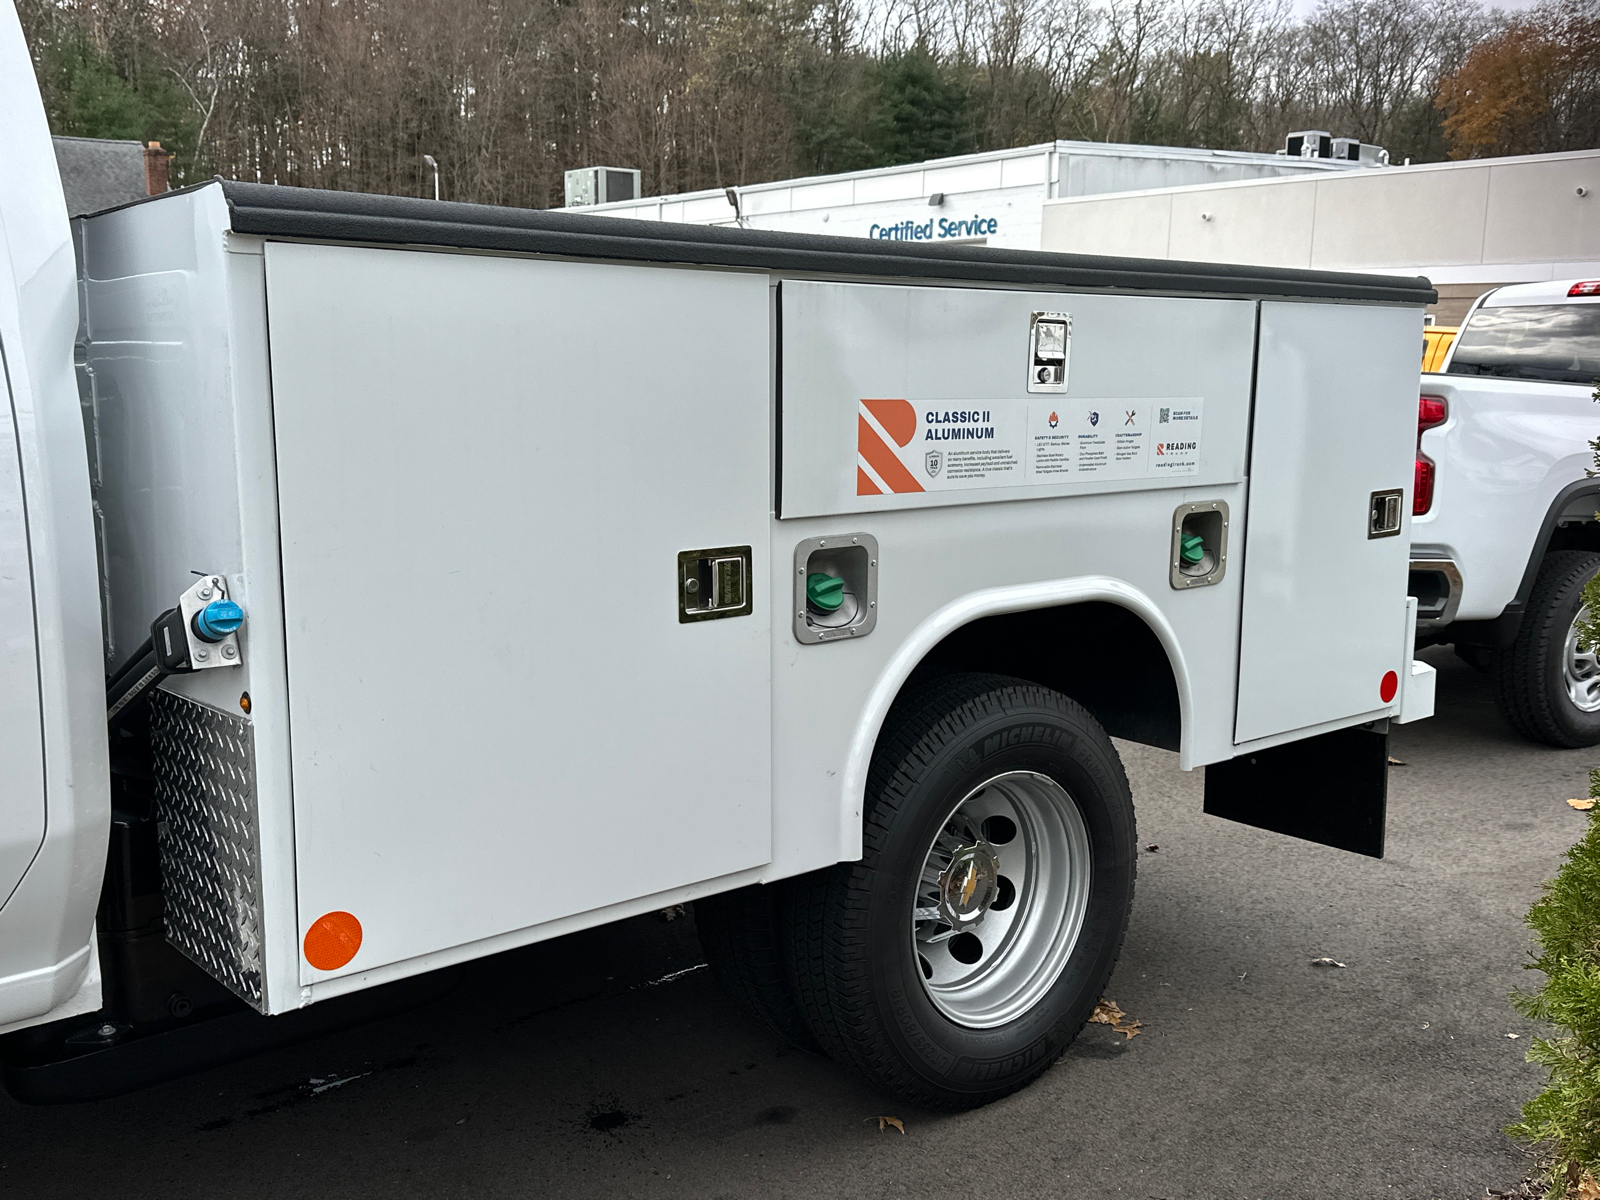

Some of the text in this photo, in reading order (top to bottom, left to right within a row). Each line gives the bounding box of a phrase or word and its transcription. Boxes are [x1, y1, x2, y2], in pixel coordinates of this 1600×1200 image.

[870, 214, 998, 241] Certified Service
[925, 411, 990, 423] CLASSIC II
[925, 427, 994, 440] ALUMINUM
[1166, 442, 1197, 450] READING
[930, 459, 938, 467] 10
[984, 727, 1074, 756] MICHELIN
[1078, 748, 1115, 801] PRIMACY
[891, 987, 950, 1069] LT235/80R18
[954, 1036, 1047, 1080] MICHELIN
